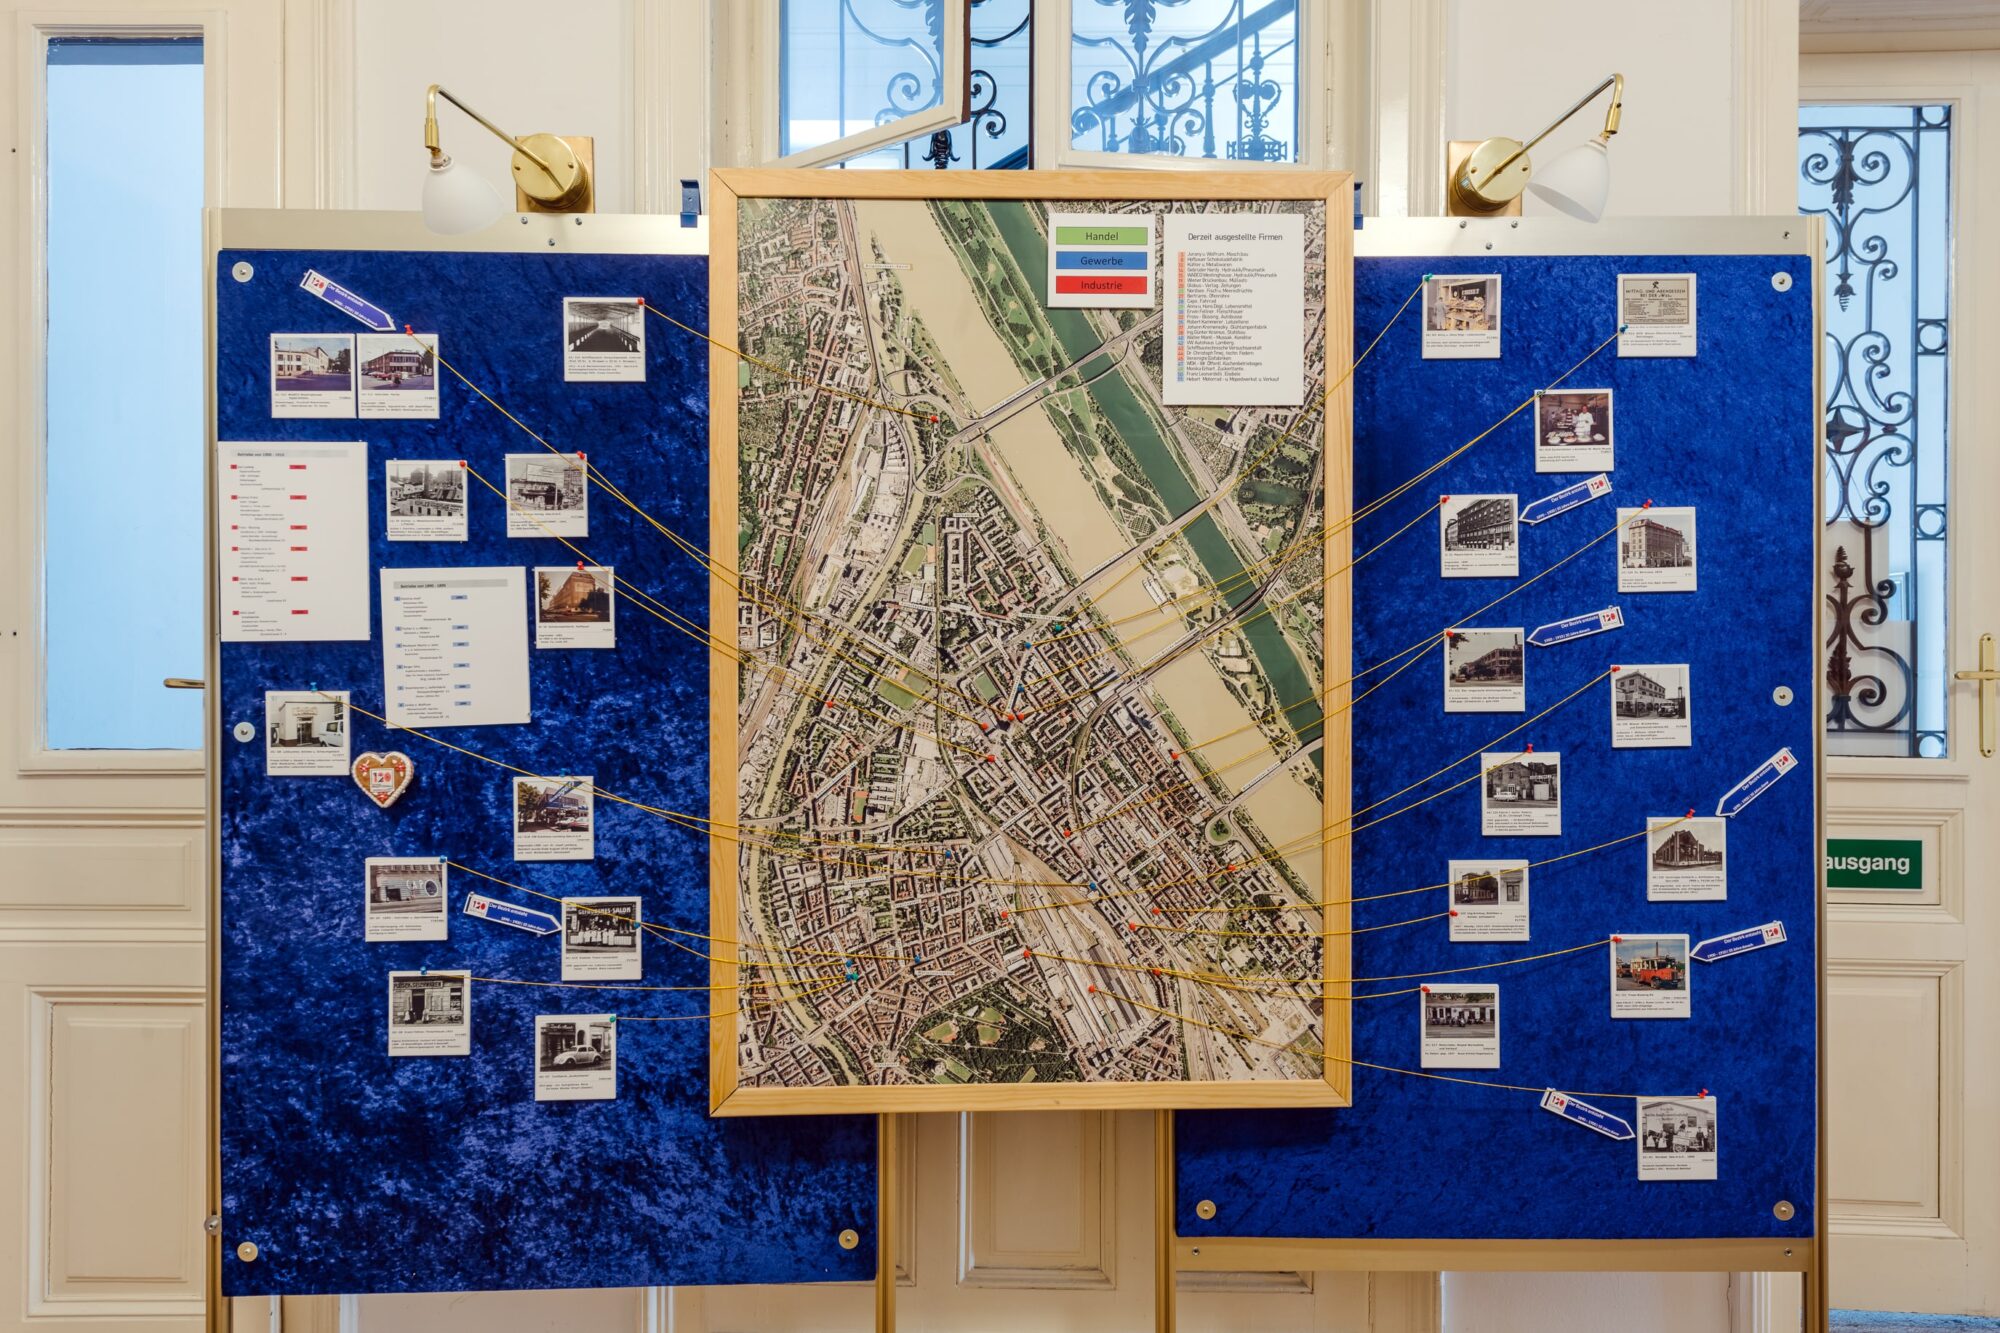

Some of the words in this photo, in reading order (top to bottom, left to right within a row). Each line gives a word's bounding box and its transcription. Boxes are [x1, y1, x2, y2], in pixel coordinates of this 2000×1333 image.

[1086, 231, 1118, 241] Handel
[1215, 233, 1256, 242] ausgestellte
[1081, 256, 1123, 266] Gewerbe
[1081, 281, 1122, 290] Industrie
[372, 772, 391, 783] 120
[1827, 856, 1910, 875] ausgang
